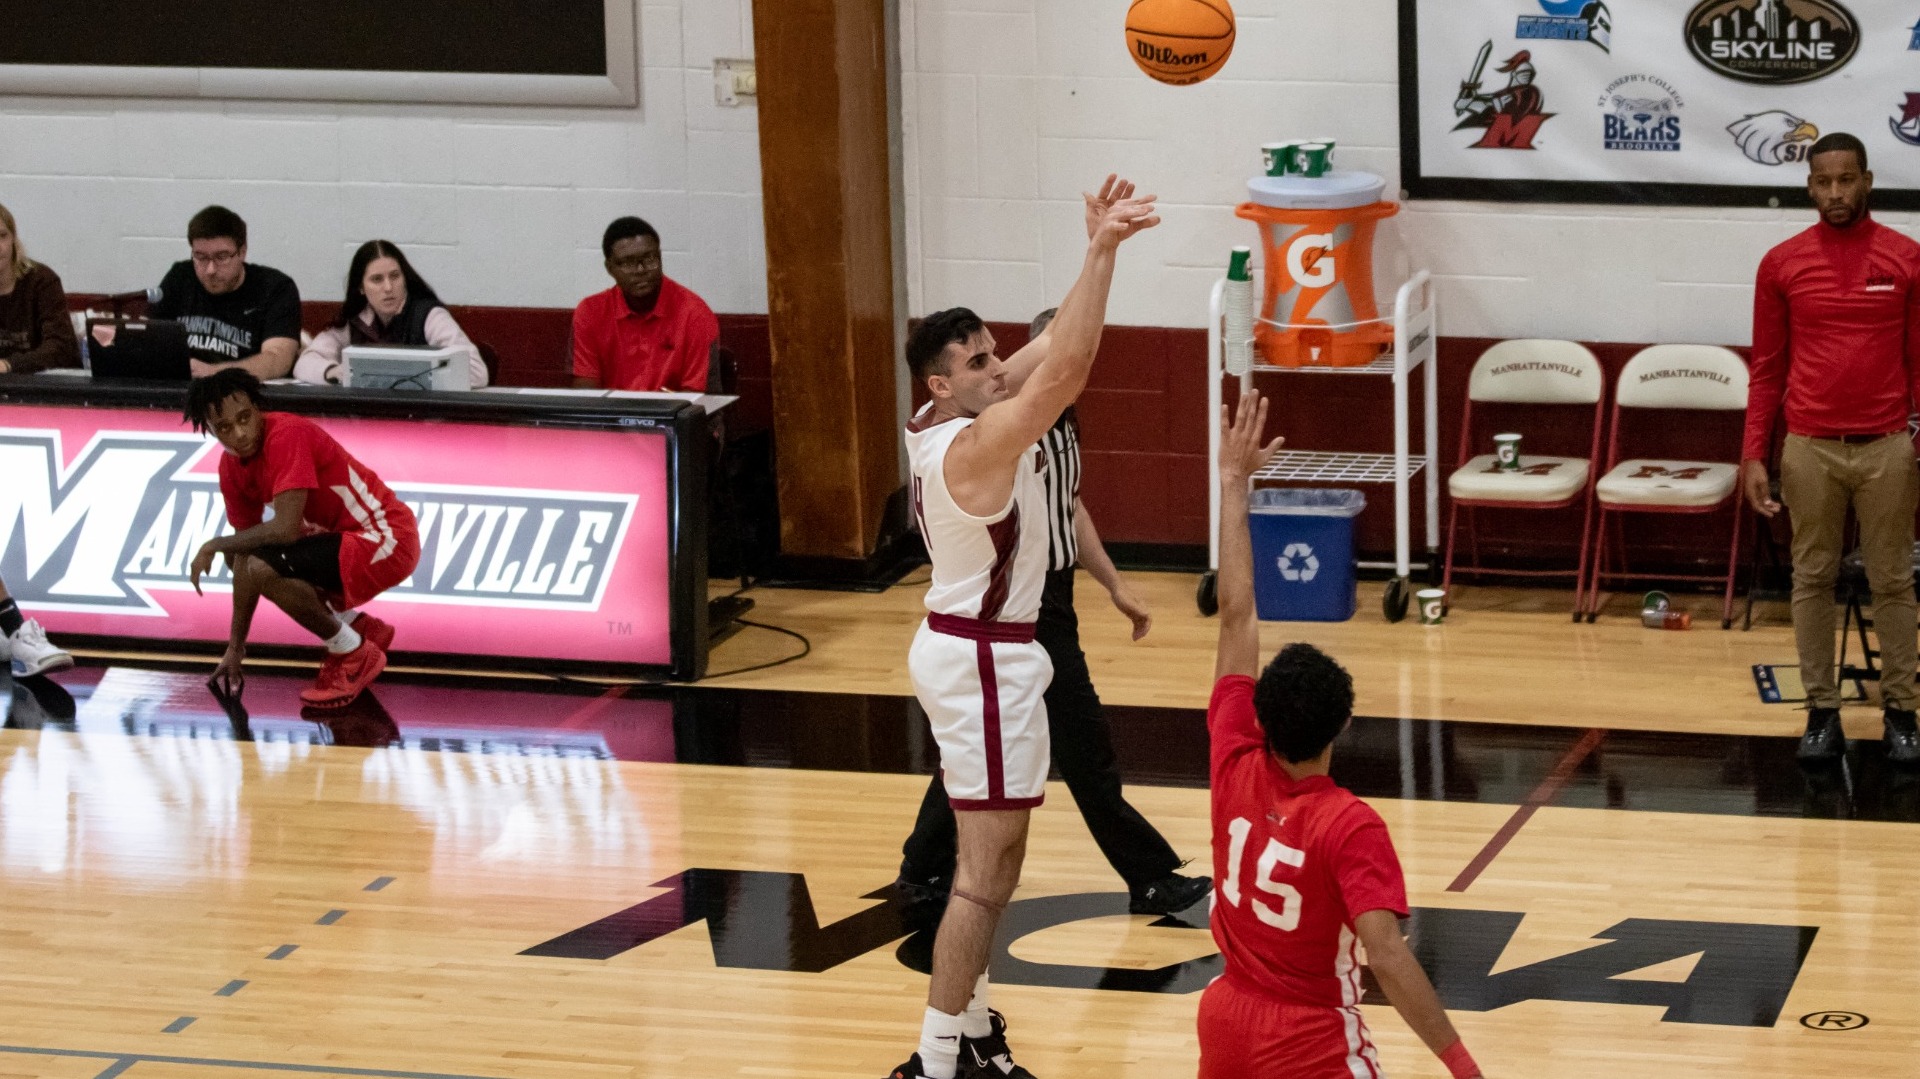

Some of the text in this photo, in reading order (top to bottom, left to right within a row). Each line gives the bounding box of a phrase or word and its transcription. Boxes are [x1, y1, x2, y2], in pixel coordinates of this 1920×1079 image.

[1136, 39, 1207, 65] Wilson
[1711, 40, 1836, 60] SKYLINE
[1729, 60, 1817, 69] CONFERENCE
[1605, 73, 1646, 94] JOSEPH'S
[1648, 75, 1684, 108] COLLEGE
[1603, 113, 1681, 141] BEARS
[1611, 141, 1674, 150] BROOKLYN
[1286, 232, 1336, 288] G
[1490, 361, 1583, 378] MANHATTANVILLE
[1639, 369, 1732, 385] MANHATTANVILLE
[1221, 816, 1306, 932] 15
